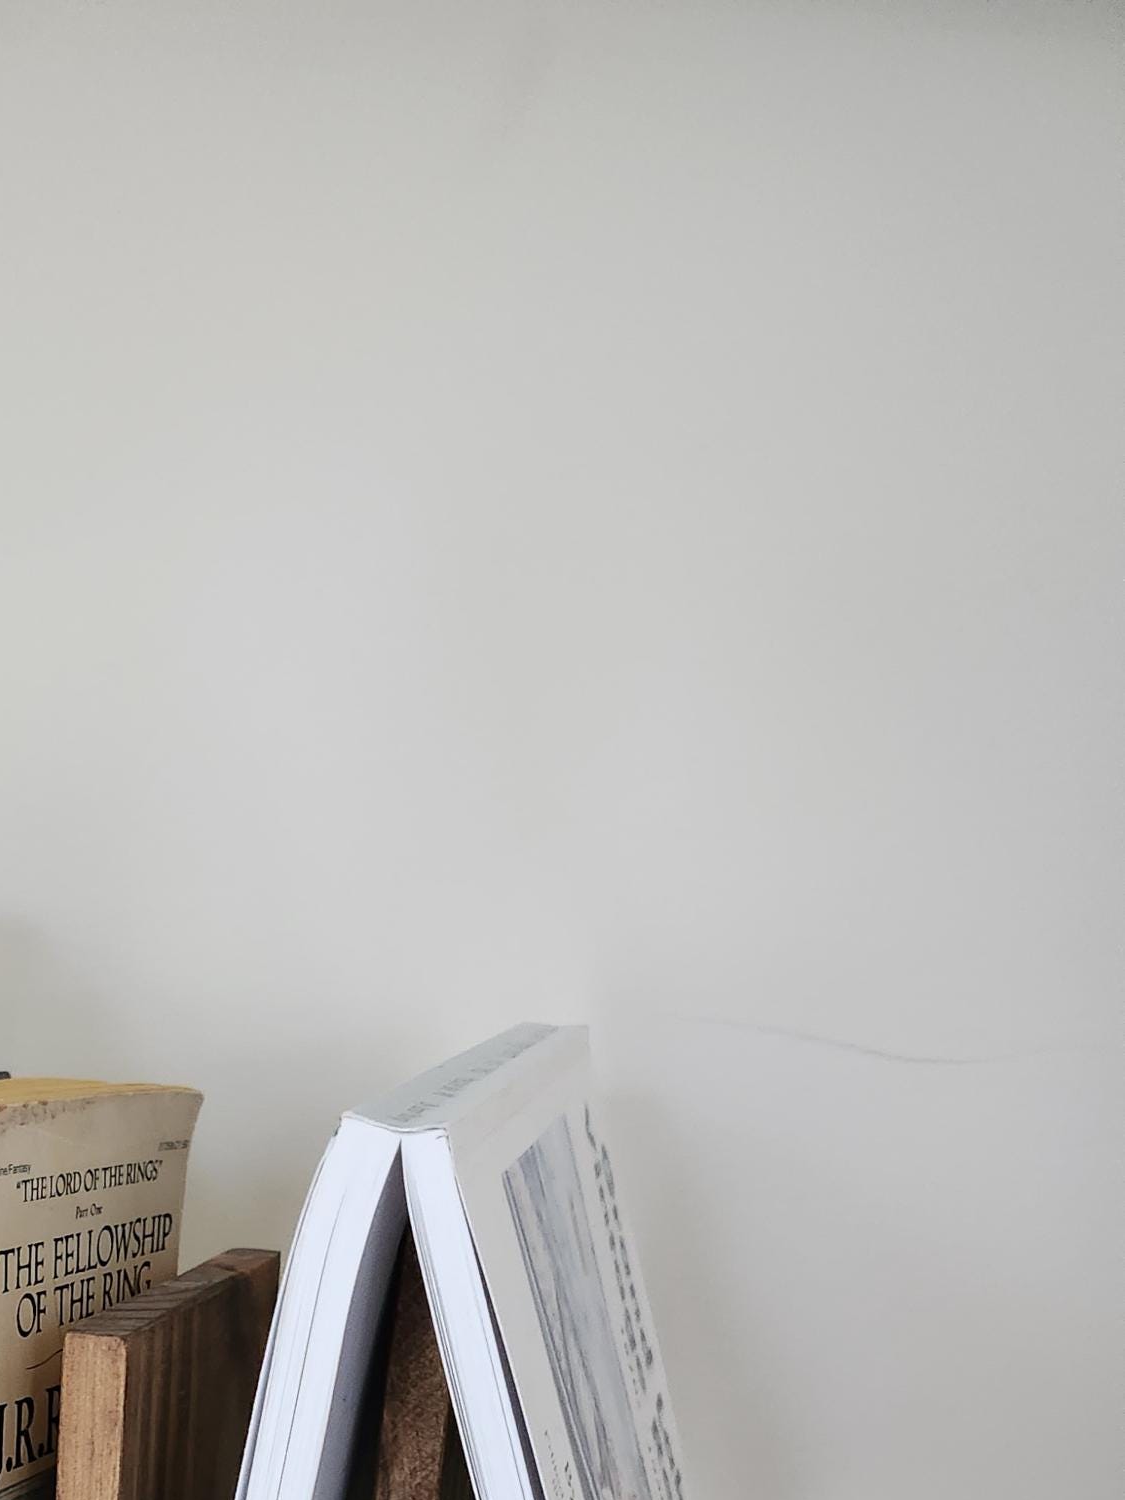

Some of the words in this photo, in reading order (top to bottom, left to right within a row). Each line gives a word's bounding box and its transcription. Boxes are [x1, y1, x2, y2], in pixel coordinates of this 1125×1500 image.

[49, 1171, 82, 1199] LORD
[83, 1168, 100, 1192] OF
[101, 1164, 125, 1189] THE
[75, 1206, 89, 1219] Part
[89, 1203, 103, 1216] One
[52, 1212, 173, 1280] FELLOWSHIP
[16, 1290, 48, 1338] OF
[53, 1276, 96, 1328] THE
[102, 1260, 152, 1311] RING
